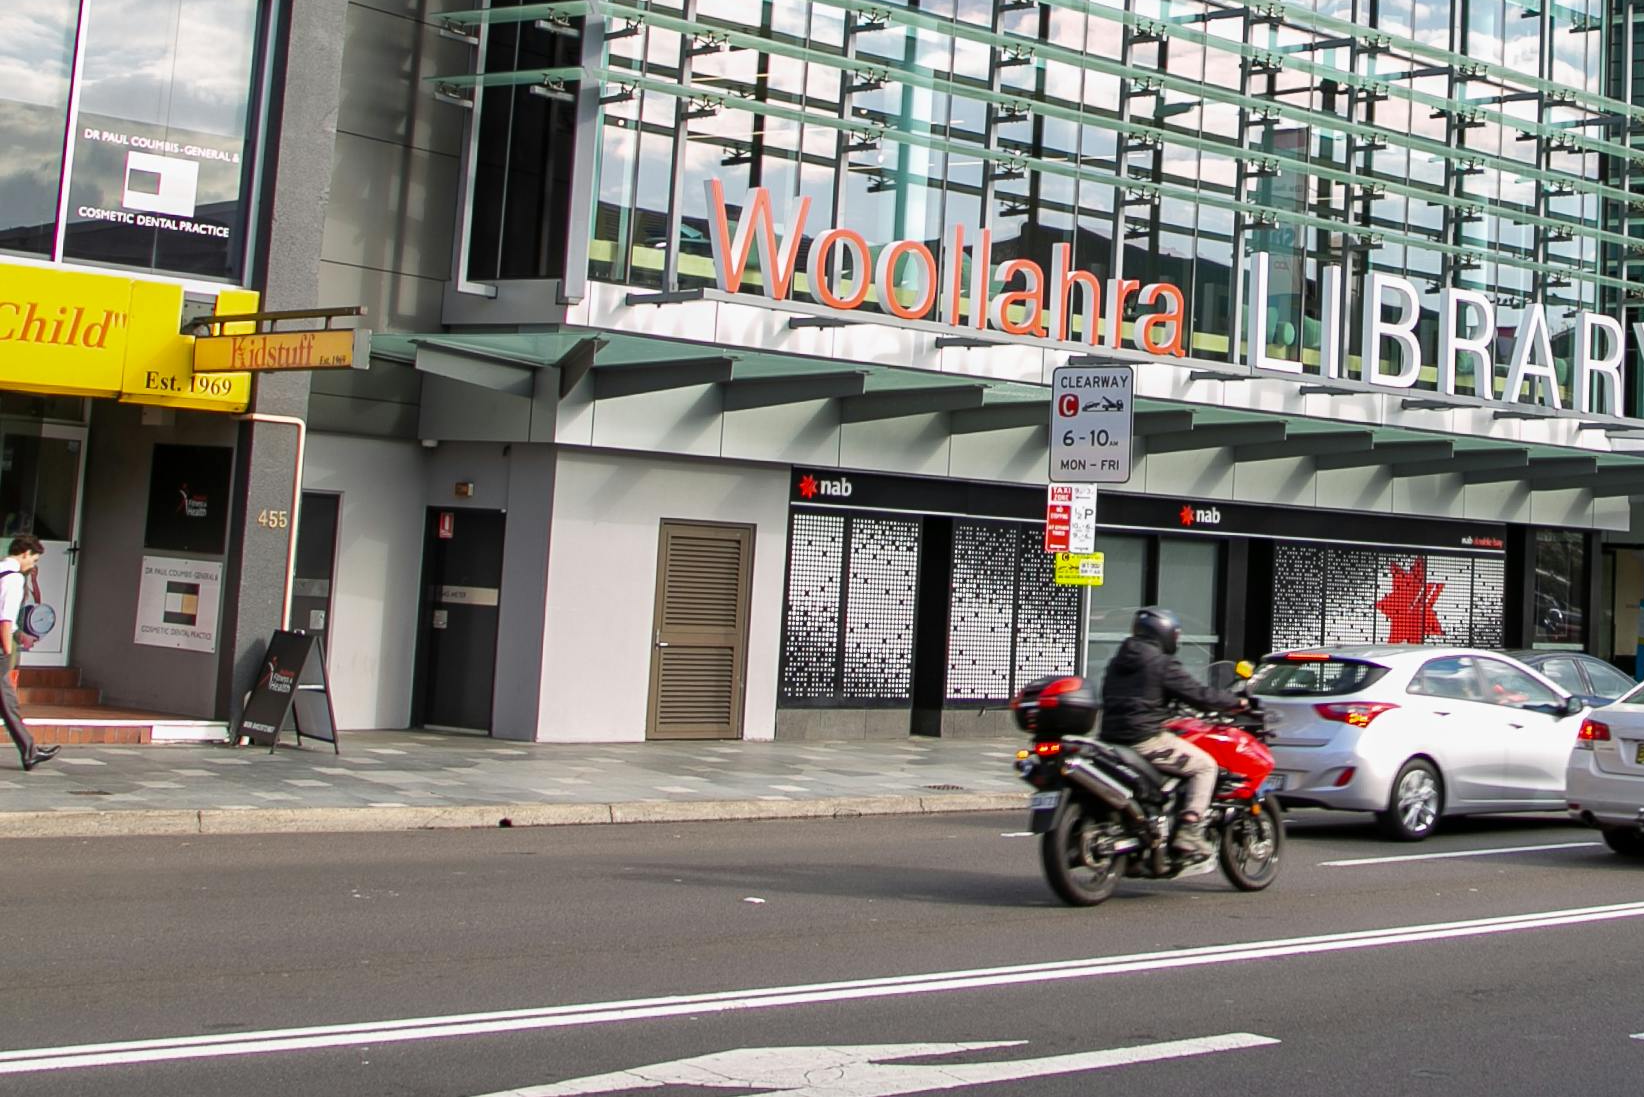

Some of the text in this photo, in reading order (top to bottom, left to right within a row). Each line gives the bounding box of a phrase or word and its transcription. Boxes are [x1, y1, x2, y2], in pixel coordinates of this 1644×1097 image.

[84, 128, 100, 140] DR
[102, 131, 129, 145] PAUL
[130, 136, 179, 153] COUMBIS
[184, 145, 231, 162] GENERAL
[231, 154, 239, 163] &
[78, 206, 230, 238] COSMETIC DENTAL PRACTICE
[703, 177, 1186, 357] Woollahra
[233, 334, 315, 369] Kidstuff
[145, 371, 232, 396] Est. 1969
[1060, 375, 1129, 389] CLEARWAY
[1060, 459, 1086, 471] MON
[1100, 459, 1119, 471] FRI
[820, 477, 852, 496] nab
[257, 509, 288, 528] 455
[1196, 506, 1221, 524] nab
